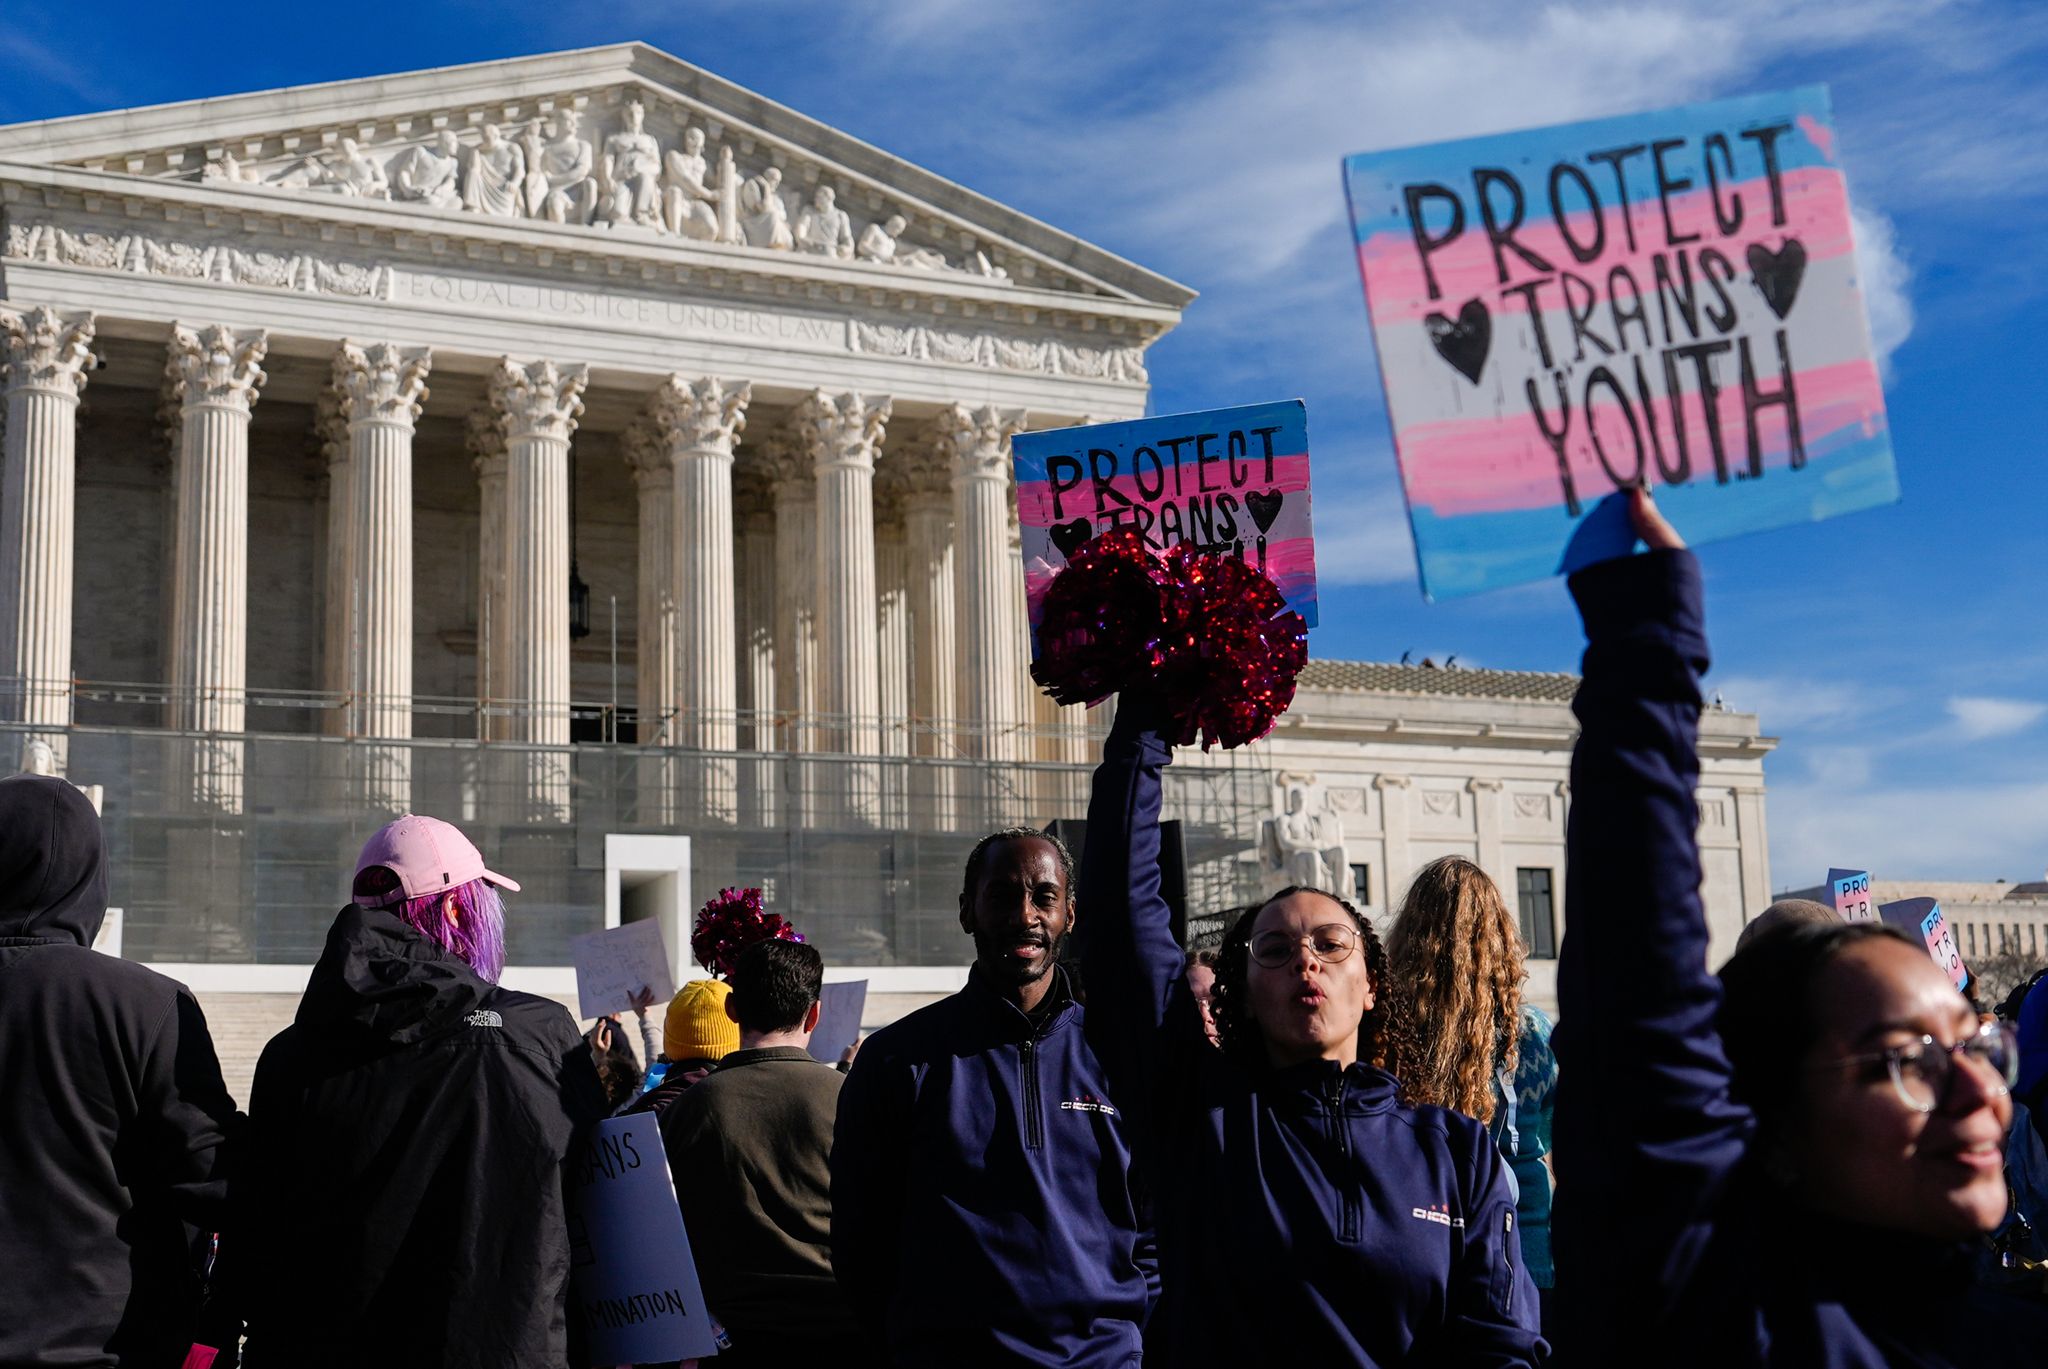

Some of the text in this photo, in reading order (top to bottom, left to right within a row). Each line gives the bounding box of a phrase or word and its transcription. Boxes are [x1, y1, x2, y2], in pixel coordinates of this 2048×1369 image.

[1403, 122, 1795, 301] PROTECT
[410, 274, 834, 341] EQUAL JUSTICE UNDER LAW
[1500, 246, 1738, 370] TRANS
[1523, 329, 1808, 518] YOUTH
[1045, 425, 1284, 521] PROTECT
[1096, 491, 1240, 551] TRANS
[1845, 901, 1868, 920] TR
